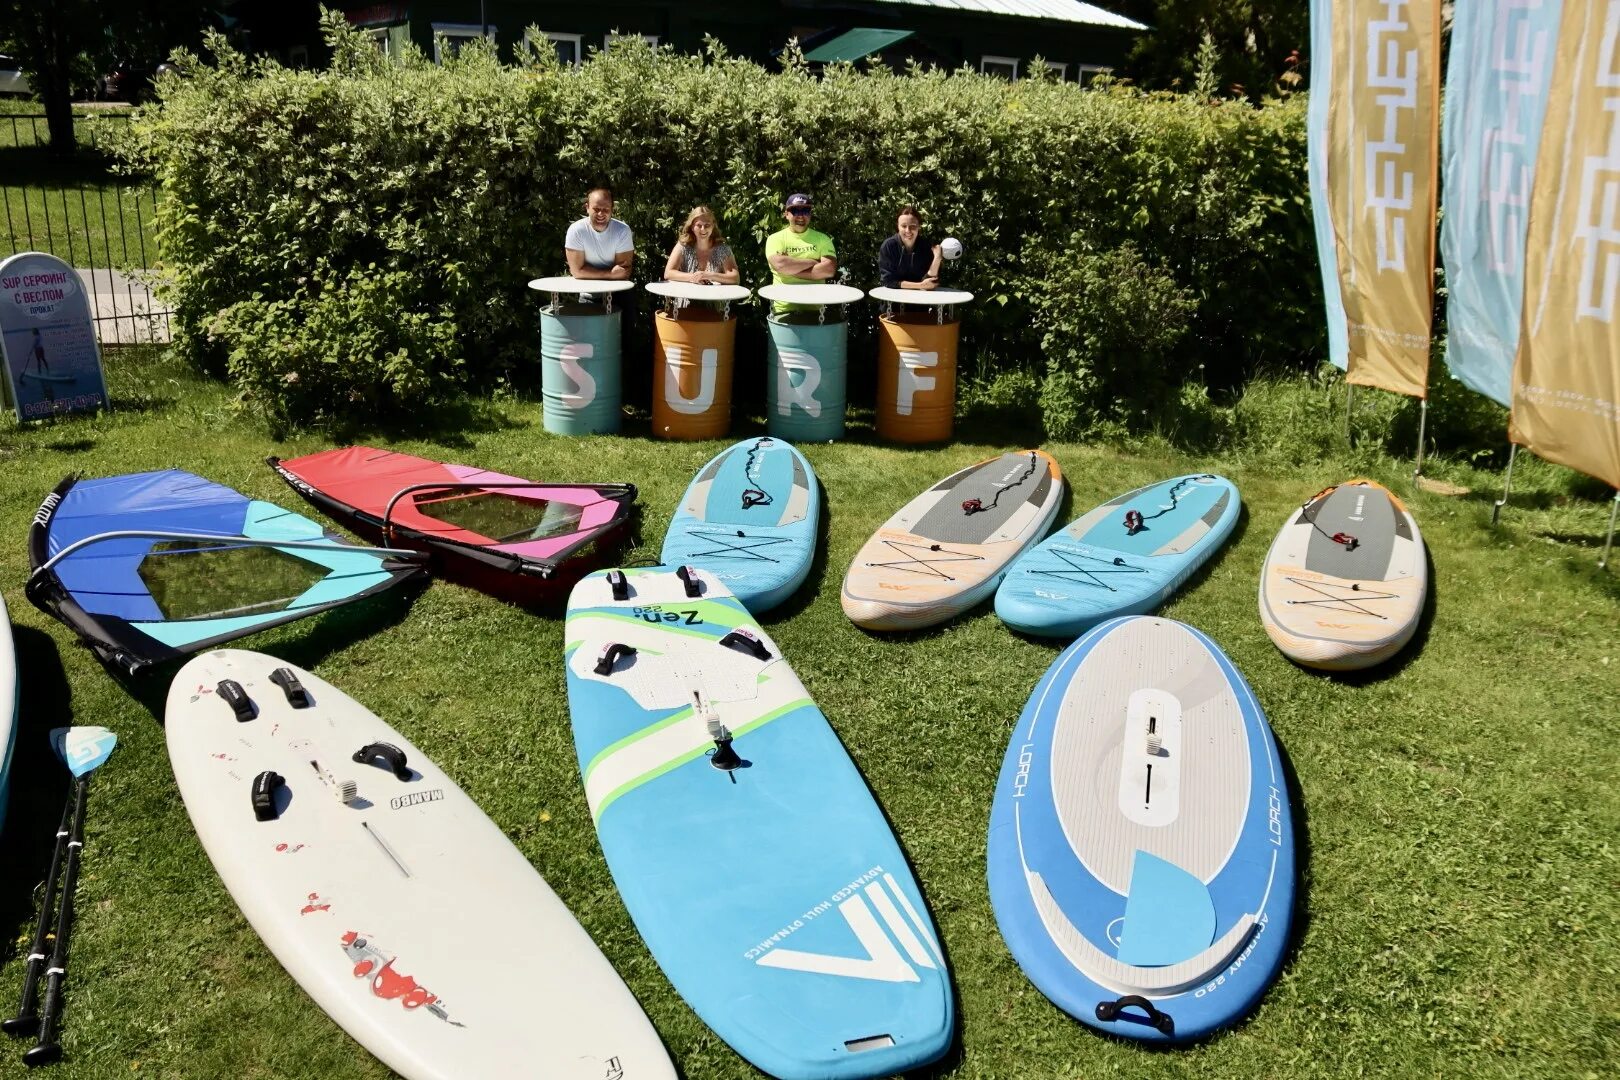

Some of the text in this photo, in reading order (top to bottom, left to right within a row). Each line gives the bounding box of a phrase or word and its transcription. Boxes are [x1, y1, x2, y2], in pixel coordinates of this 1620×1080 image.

[2, 272, 67, 290] SUP СЕРФИНГ
[14, 288, 65, 304] С ВЕСЛОМ
[30, 304, 55, 314] ПРОКАТ
[31, 492, 61, 528] NAUTIX
[633, 605, 663, 614] 220
[1012, 743, 1034, 798] LORCH
[391, 789, 444, 811] MAMBO
[1269, 785, 1281, 847] LORCH
[743, 864, 884, 960] ADVANCED HULL DYNAMICS
[1194, 975, 1226, 998] 220
